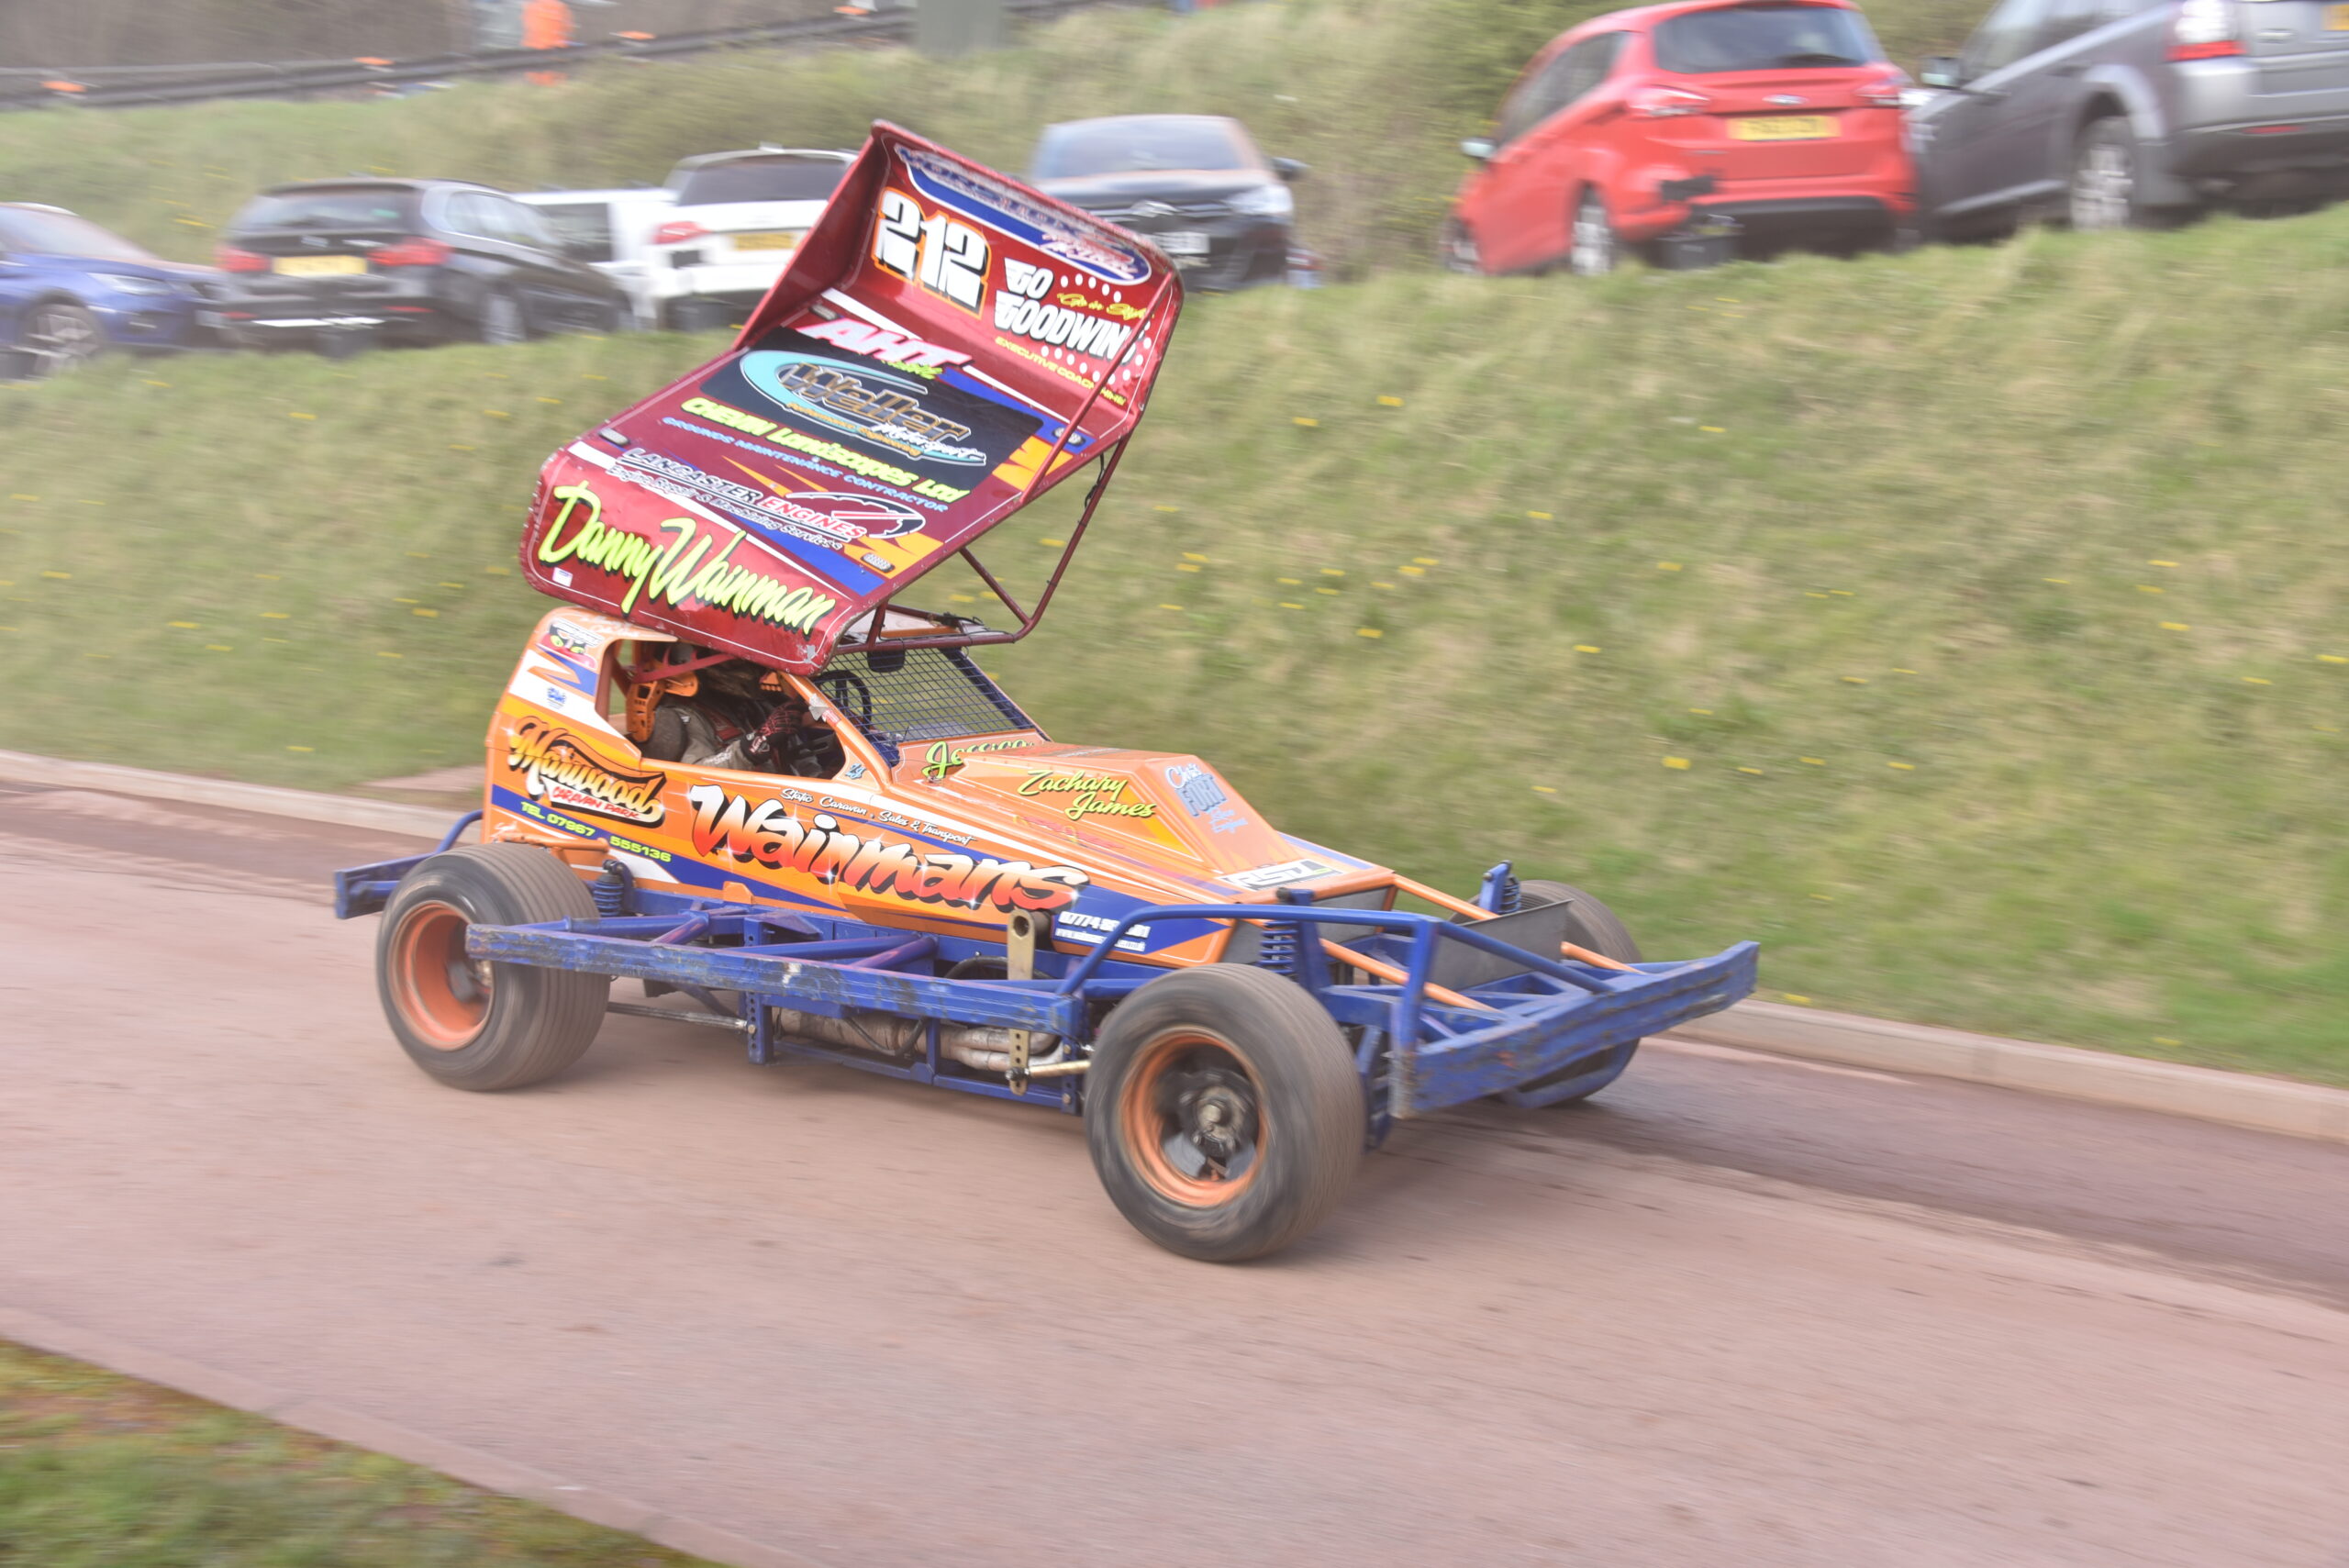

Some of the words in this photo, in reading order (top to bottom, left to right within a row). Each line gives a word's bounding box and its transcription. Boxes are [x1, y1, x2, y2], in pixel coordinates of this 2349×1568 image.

[873, 188, 990, 316] 212
[1004, 257, 1054, 300] GO
[796, 317, 973, 368] AHT
[995, 336, 1058, 373] EXECUTIVE
[778, 361, 972, 441] Weller
[735, 439, 843, 478] MAINTENANCE
[842, 474, 949, 513] CONTRACTOR
[765, 427, 919, 487] Landscapes
[606, 464, 654, 486] Engine
[709, 497, 782, 530] Machining
[781, 521, 843, 550] Services
[623, 448, 763, 505] LANCASTER
[759, 496, 867, 539] ENGINES
[539, 479, 663, 617] Danny
[648, 517, 836, 640] Wainman
[520, 801, 546, 819] TEL
[551, 785, 602, 809] CARAVAN
[604, 802, 641, 820] PARK
[1017, 769, 1129, 803] Zachary
[1064, 791, 1157, 822] James
[780, 788, 814, 804] Static
[819, 796, 867, 816] Caravan
[877, 810, 909, 828] Sales
[910, 820, 920, 832] &
[922, 822, 977, 846] Transport
